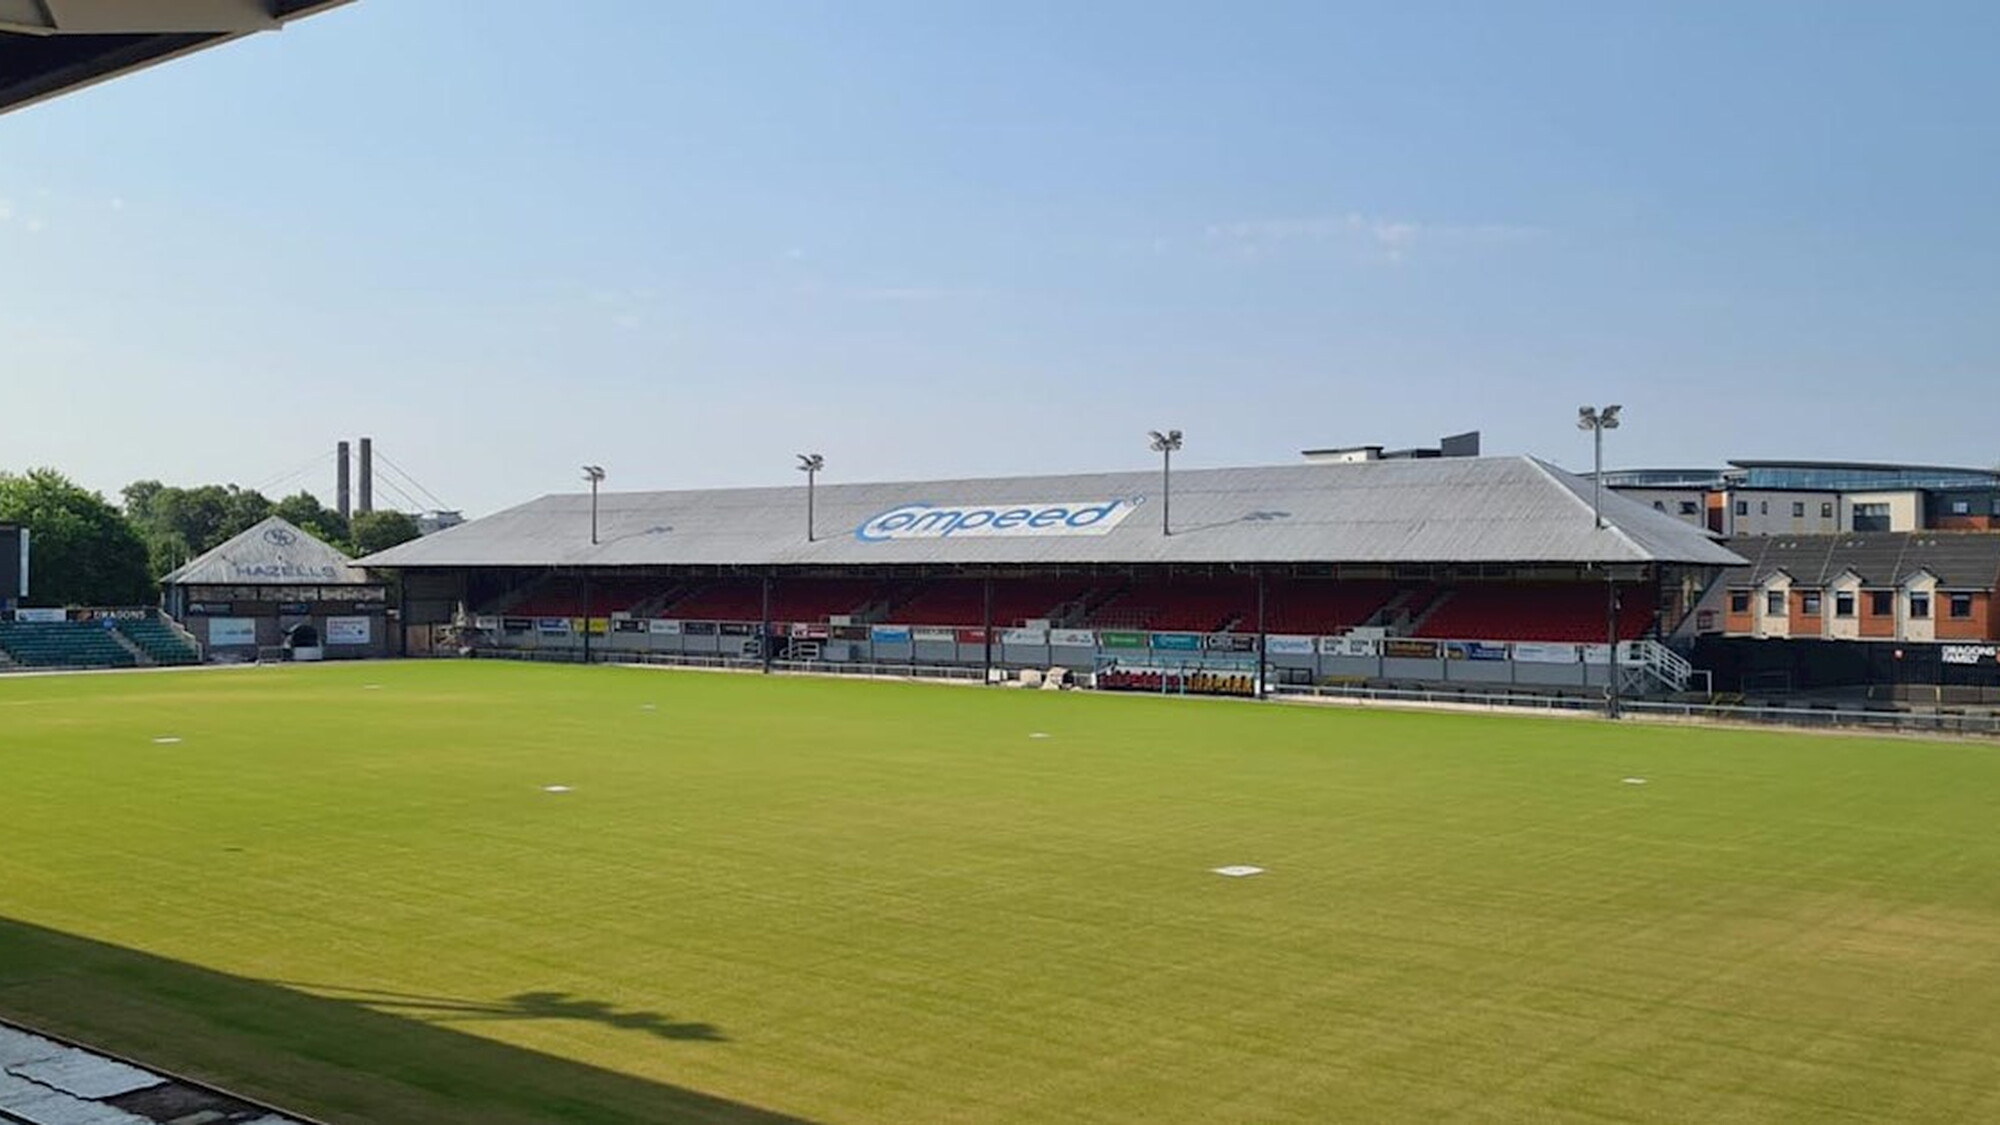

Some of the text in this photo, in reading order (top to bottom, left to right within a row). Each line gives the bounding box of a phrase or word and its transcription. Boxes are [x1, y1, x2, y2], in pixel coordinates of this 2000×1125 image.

[855, 499, 1124, 541] Compeed
[235, 564, 336, 577] HAZELLS
[1942, 645, 1996, 656] DRAGONS
